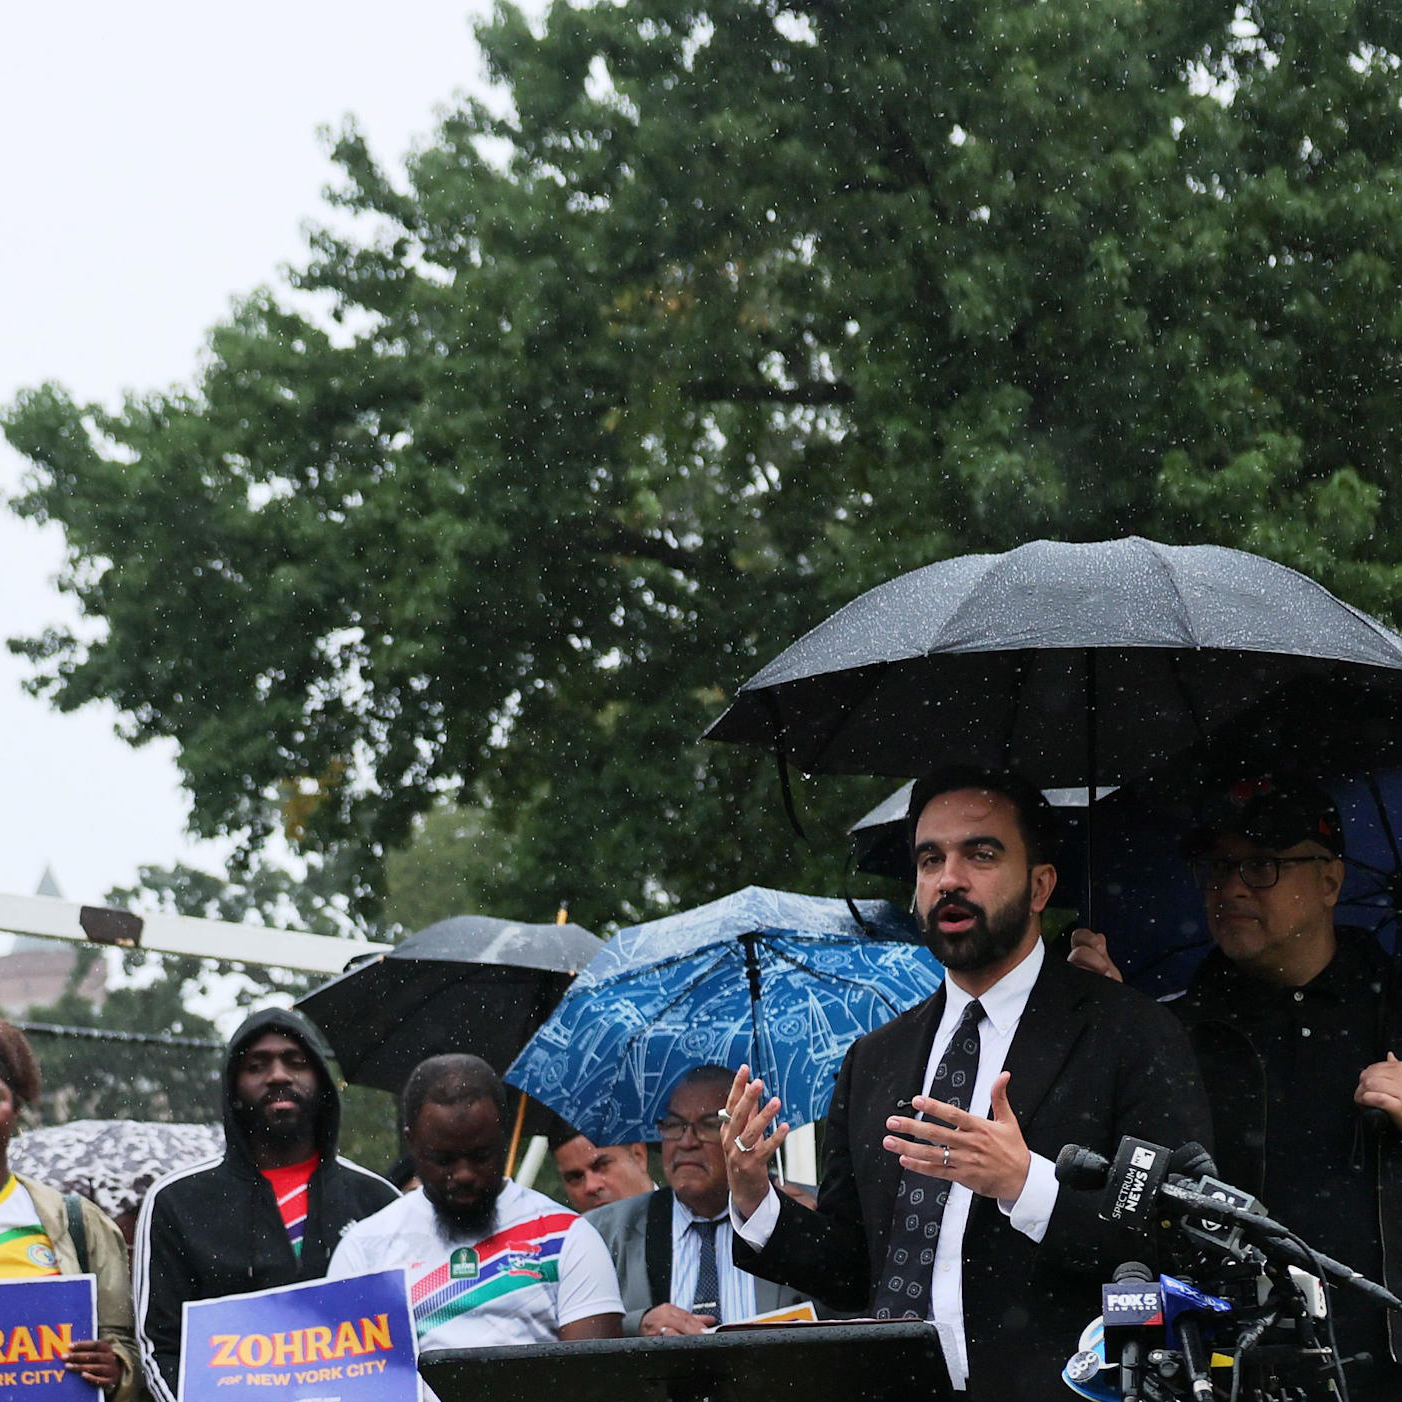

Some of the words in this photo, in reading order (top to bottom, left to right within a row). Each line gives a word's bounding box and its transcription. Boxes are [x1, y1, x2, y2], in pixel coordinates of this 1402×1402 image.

[1112, 1167, 1137, 1219] SPECTRUM
[1124, 1170, 1148, 1212] NEWS
[208, 1313, 395, 1368] ZOHRAN
[21, 1370, 66, 1386] CITY
[217, 1375, 243, 1387] FOR
[246, 1373, 291, 1387] NEW
[295, 1366, 343, 1385] YORK
[346, 1360, 388, 1377] CITY
[1068, 1352, 1097, 1379] abc
